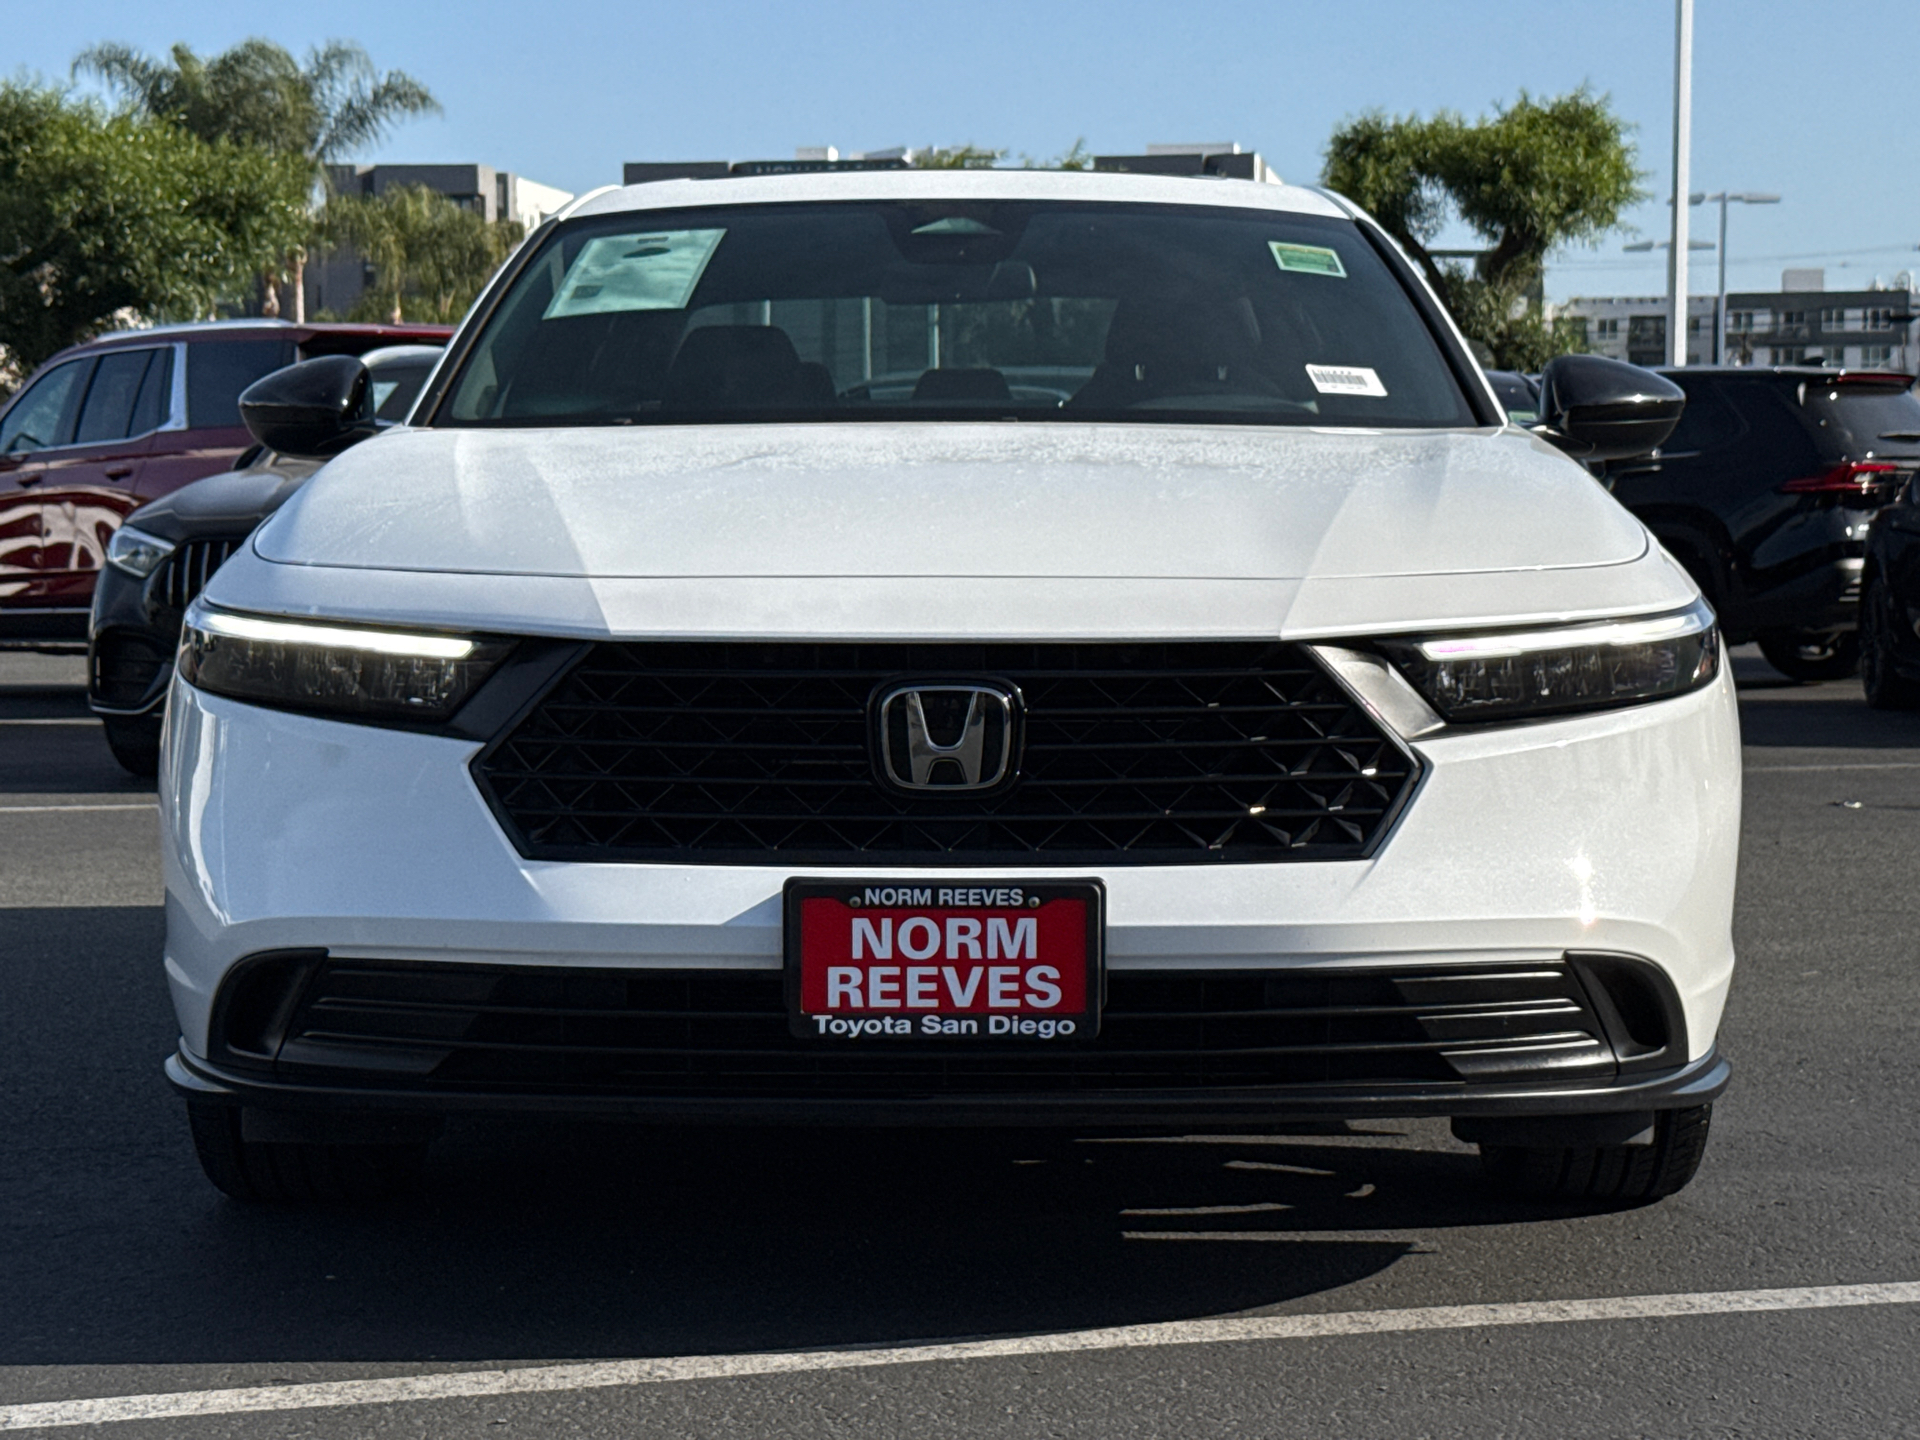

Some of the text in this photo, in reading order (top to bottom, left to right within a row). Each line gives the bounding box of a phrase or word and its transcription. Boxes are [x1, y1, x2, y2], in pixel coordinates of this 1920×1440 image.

[864, 888, 1024, 906] NORM REEVES
[852, 917, 1037, 960] NORM
[827, 965, 1062, 1008] REEVES
[812, 1015, 1076, 1039] Toyota San Diego
